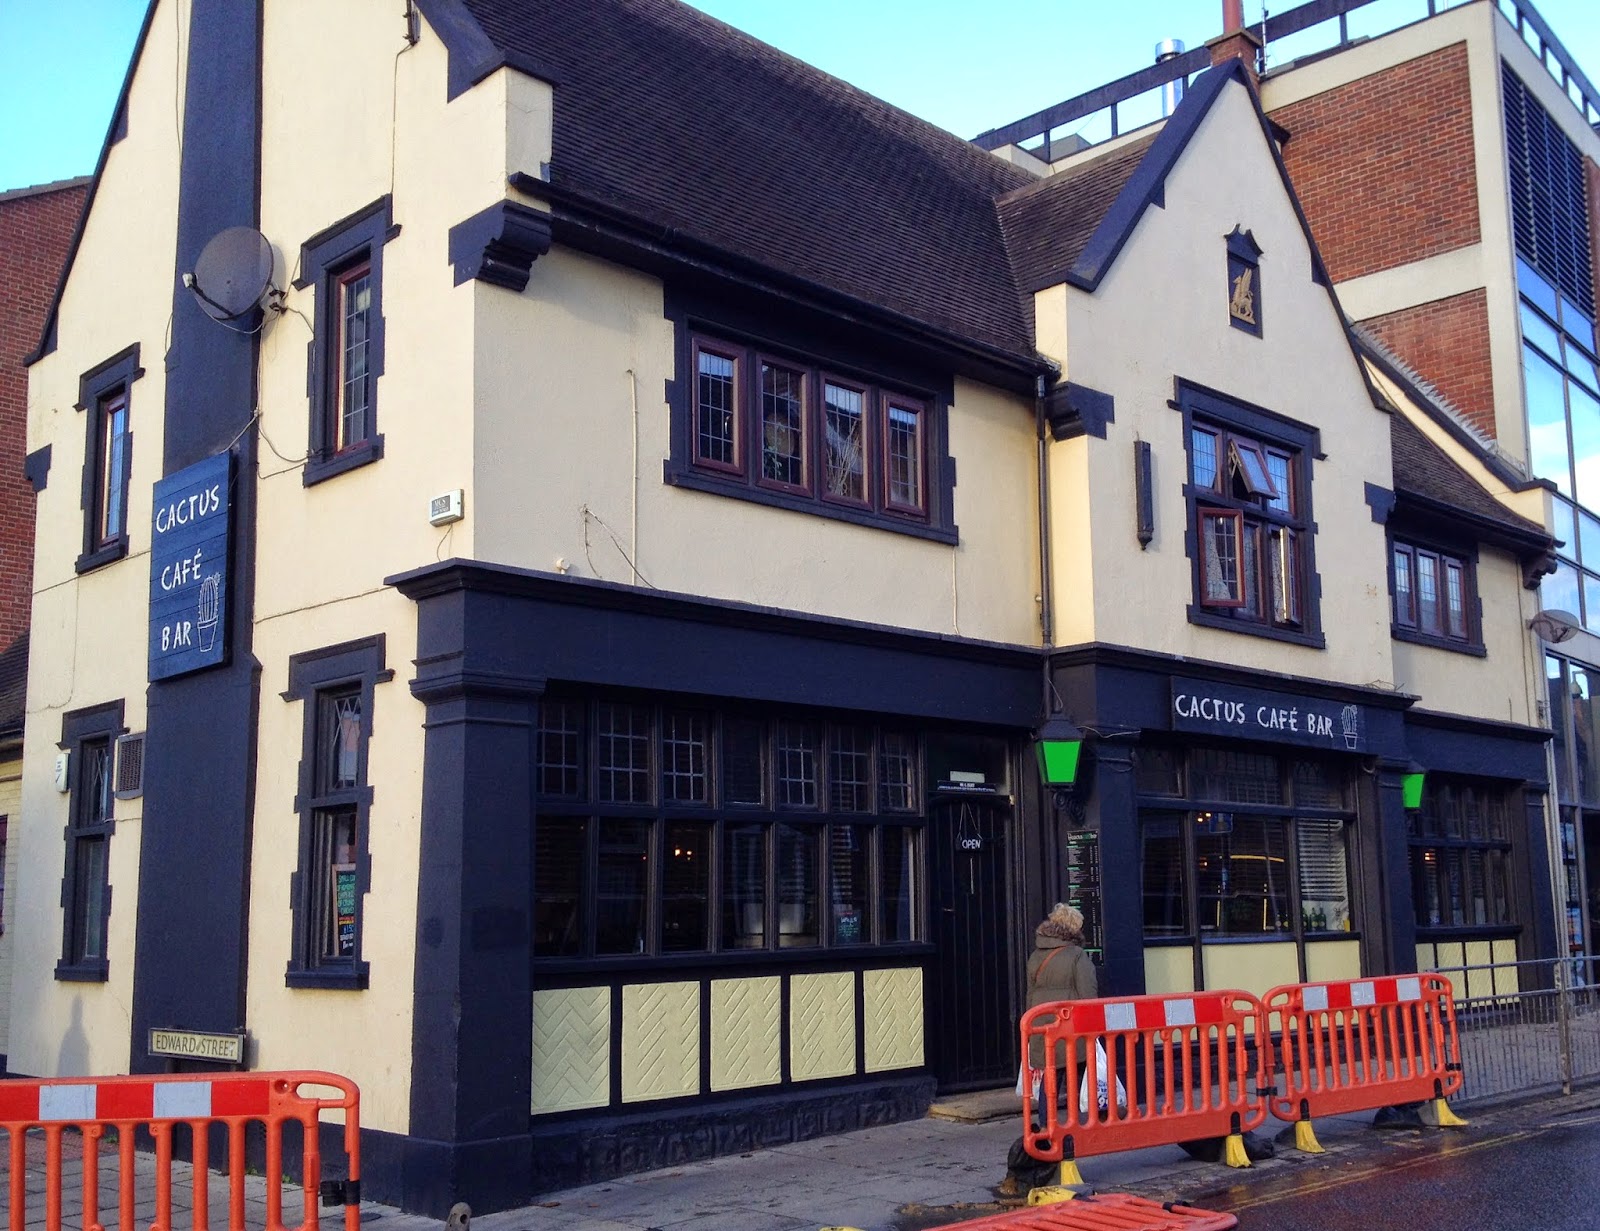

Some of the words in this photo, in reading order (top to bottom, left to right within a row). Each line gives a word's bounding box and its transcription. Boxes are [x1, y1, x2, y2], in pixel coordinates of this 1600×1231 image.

[156, 484, 220, 534] CACTUS
[160, 548, 203, 591] CAFÉ
[161, 621, 191, 652] BAR
[1174, 694, 1246, 725] CACTUS
[1256, 707, 1298, 732] CAFÉ
[1307, 713, 1334, 739] BAR
[962, 839, 981, 849] OPEN
[156, 1034, 196, 1053] EDWARD
[201, 1038, 236, 1057] STREET
